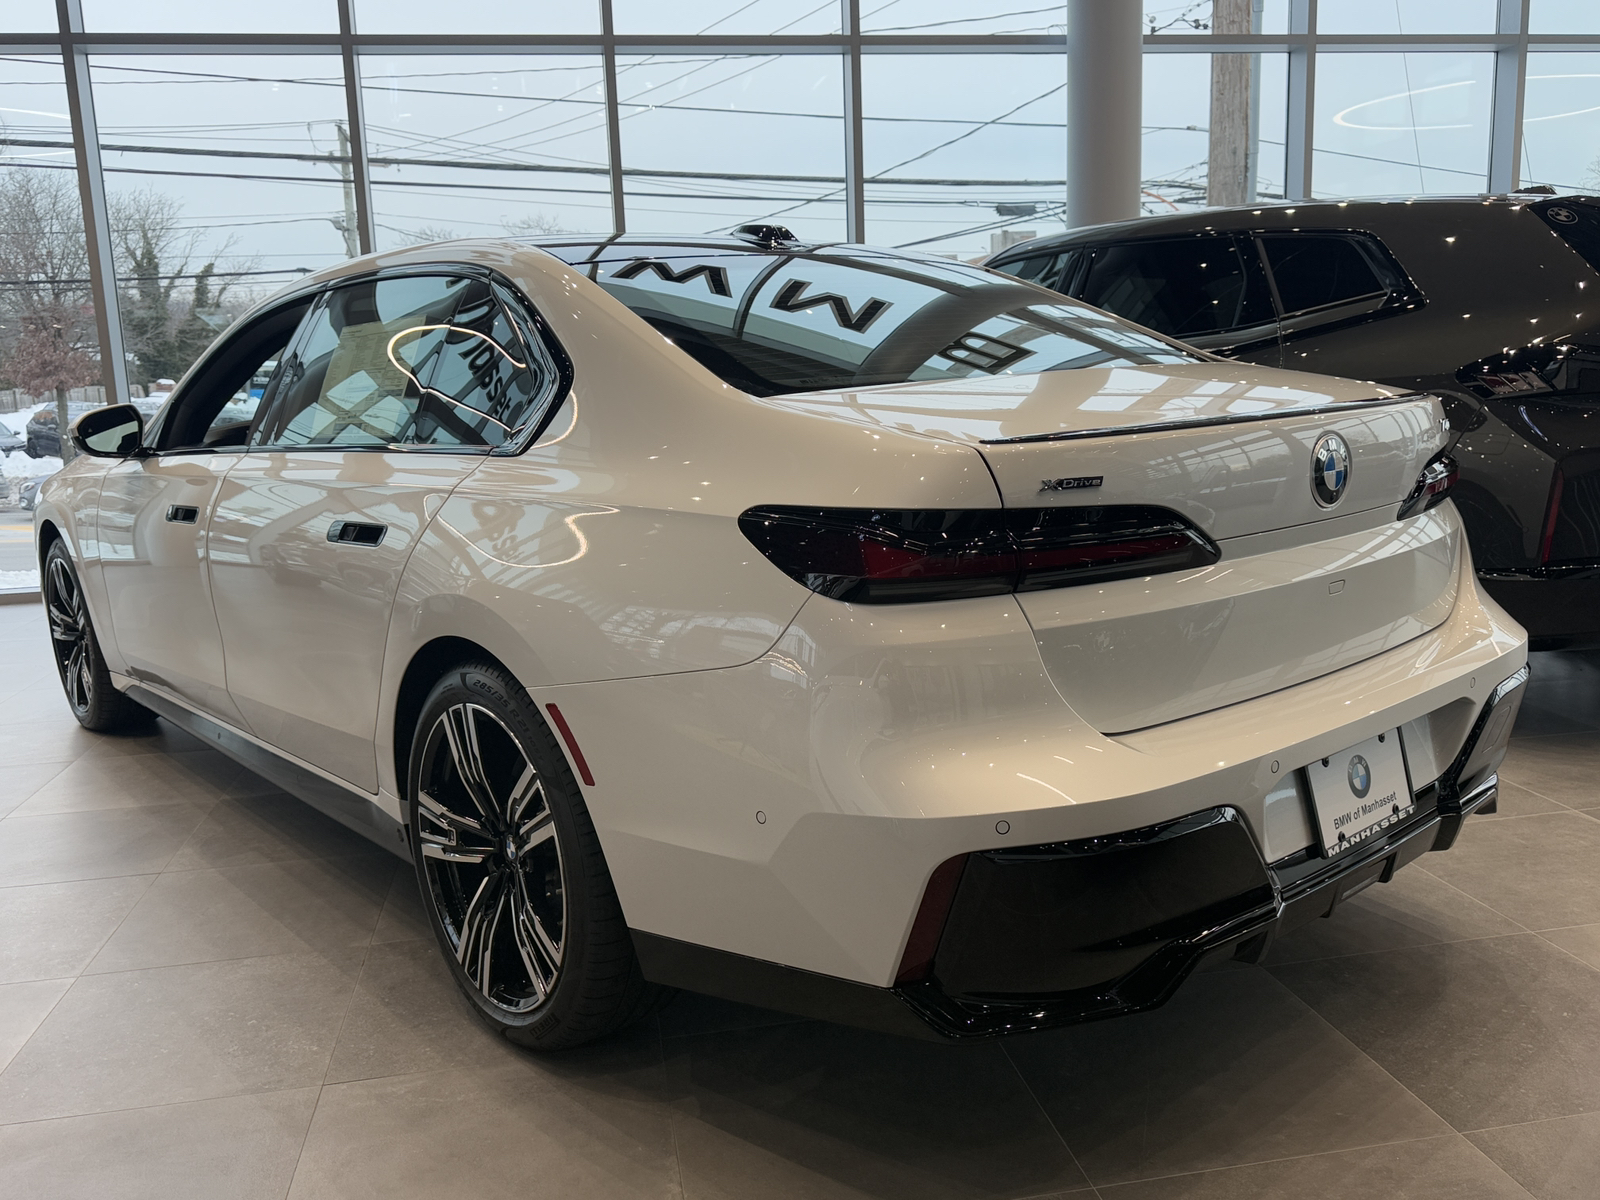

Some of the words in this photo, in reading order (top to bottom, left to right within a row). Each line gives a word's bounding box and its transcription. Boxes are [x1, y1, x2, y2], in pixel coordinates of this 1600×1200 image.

[473, 680, 511, 708] 285/35
[1333, 811, 1352, 830] BMW
[1353, 807, 1361, 820] of
[1361, 791, 1397, 815] Manhasset
[1327, 805, 1416, 858] MANHASSET
